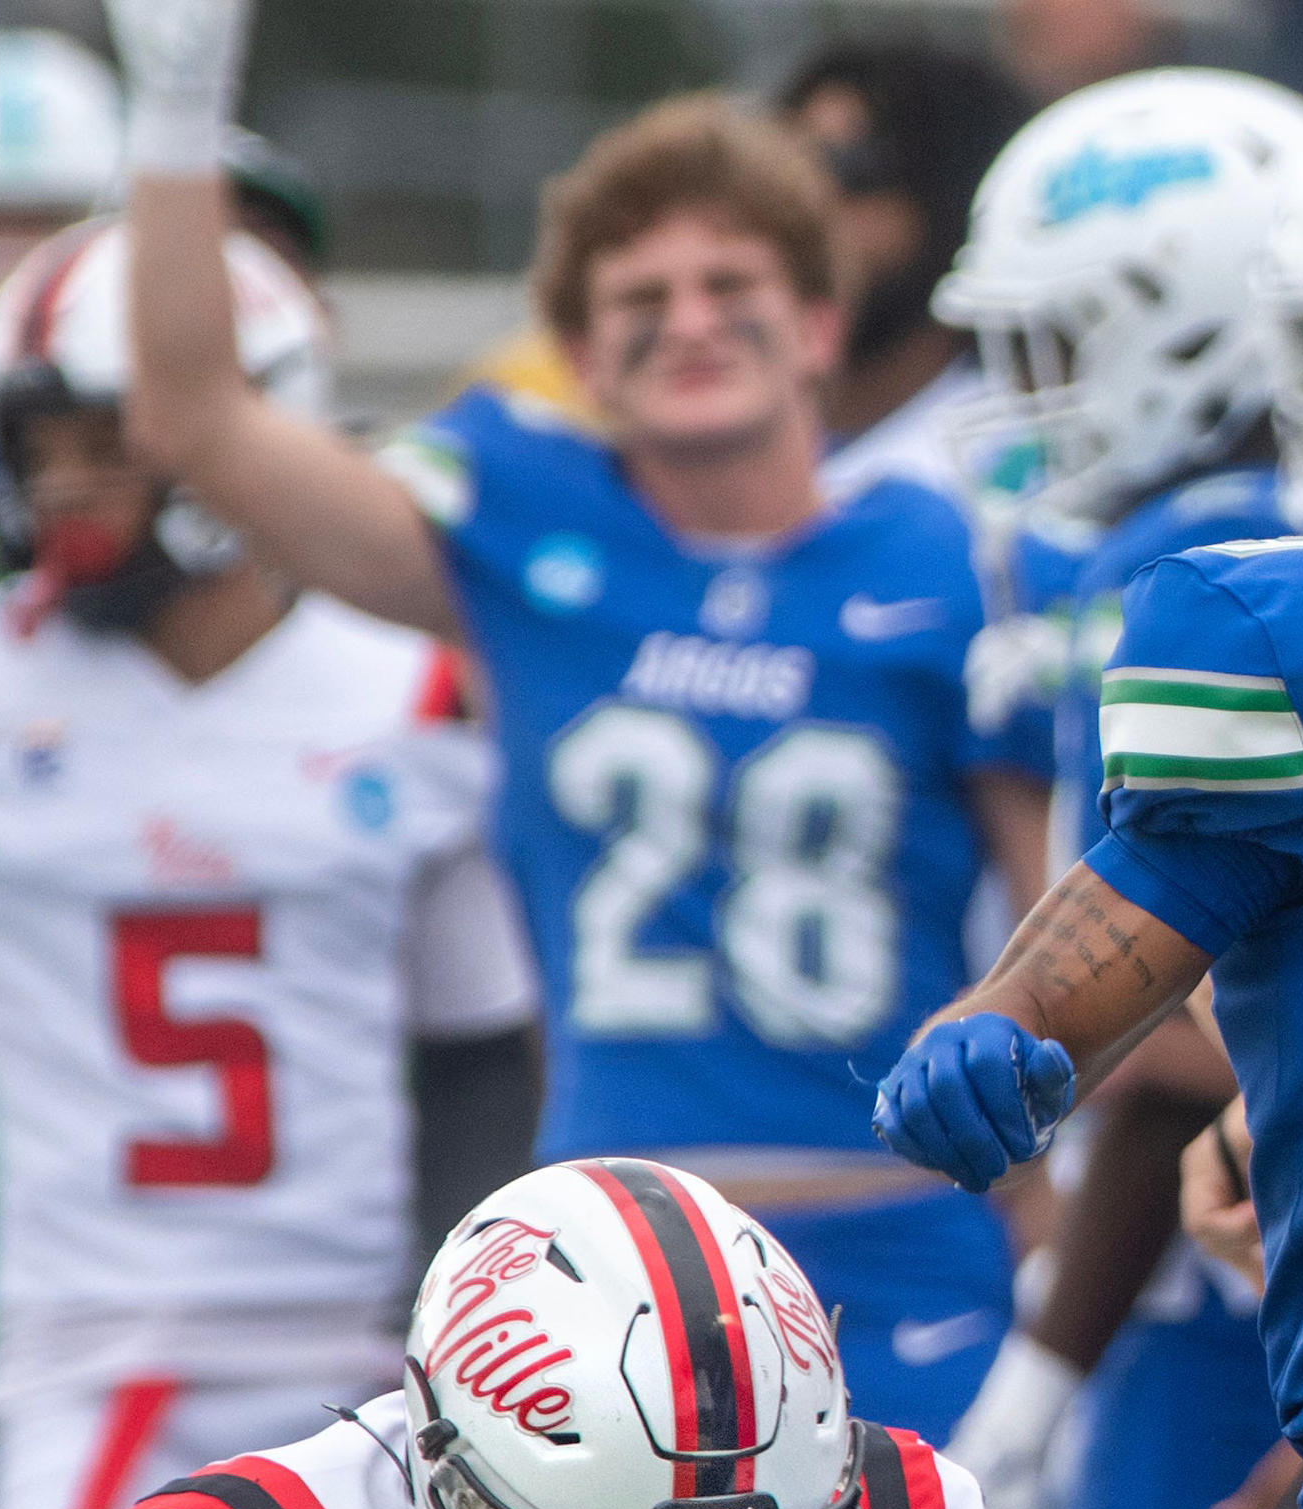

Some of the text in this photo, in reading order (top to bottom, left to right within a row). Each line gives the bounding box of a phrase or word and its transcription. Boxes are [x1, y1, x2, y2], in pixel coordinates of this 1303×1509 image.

[550, 699, 900, 1050] 28
[112, 905, 274, 1186] 5
[425, 1276, 572, 1432] Ville
[449, 1219, 555, 1284] The
